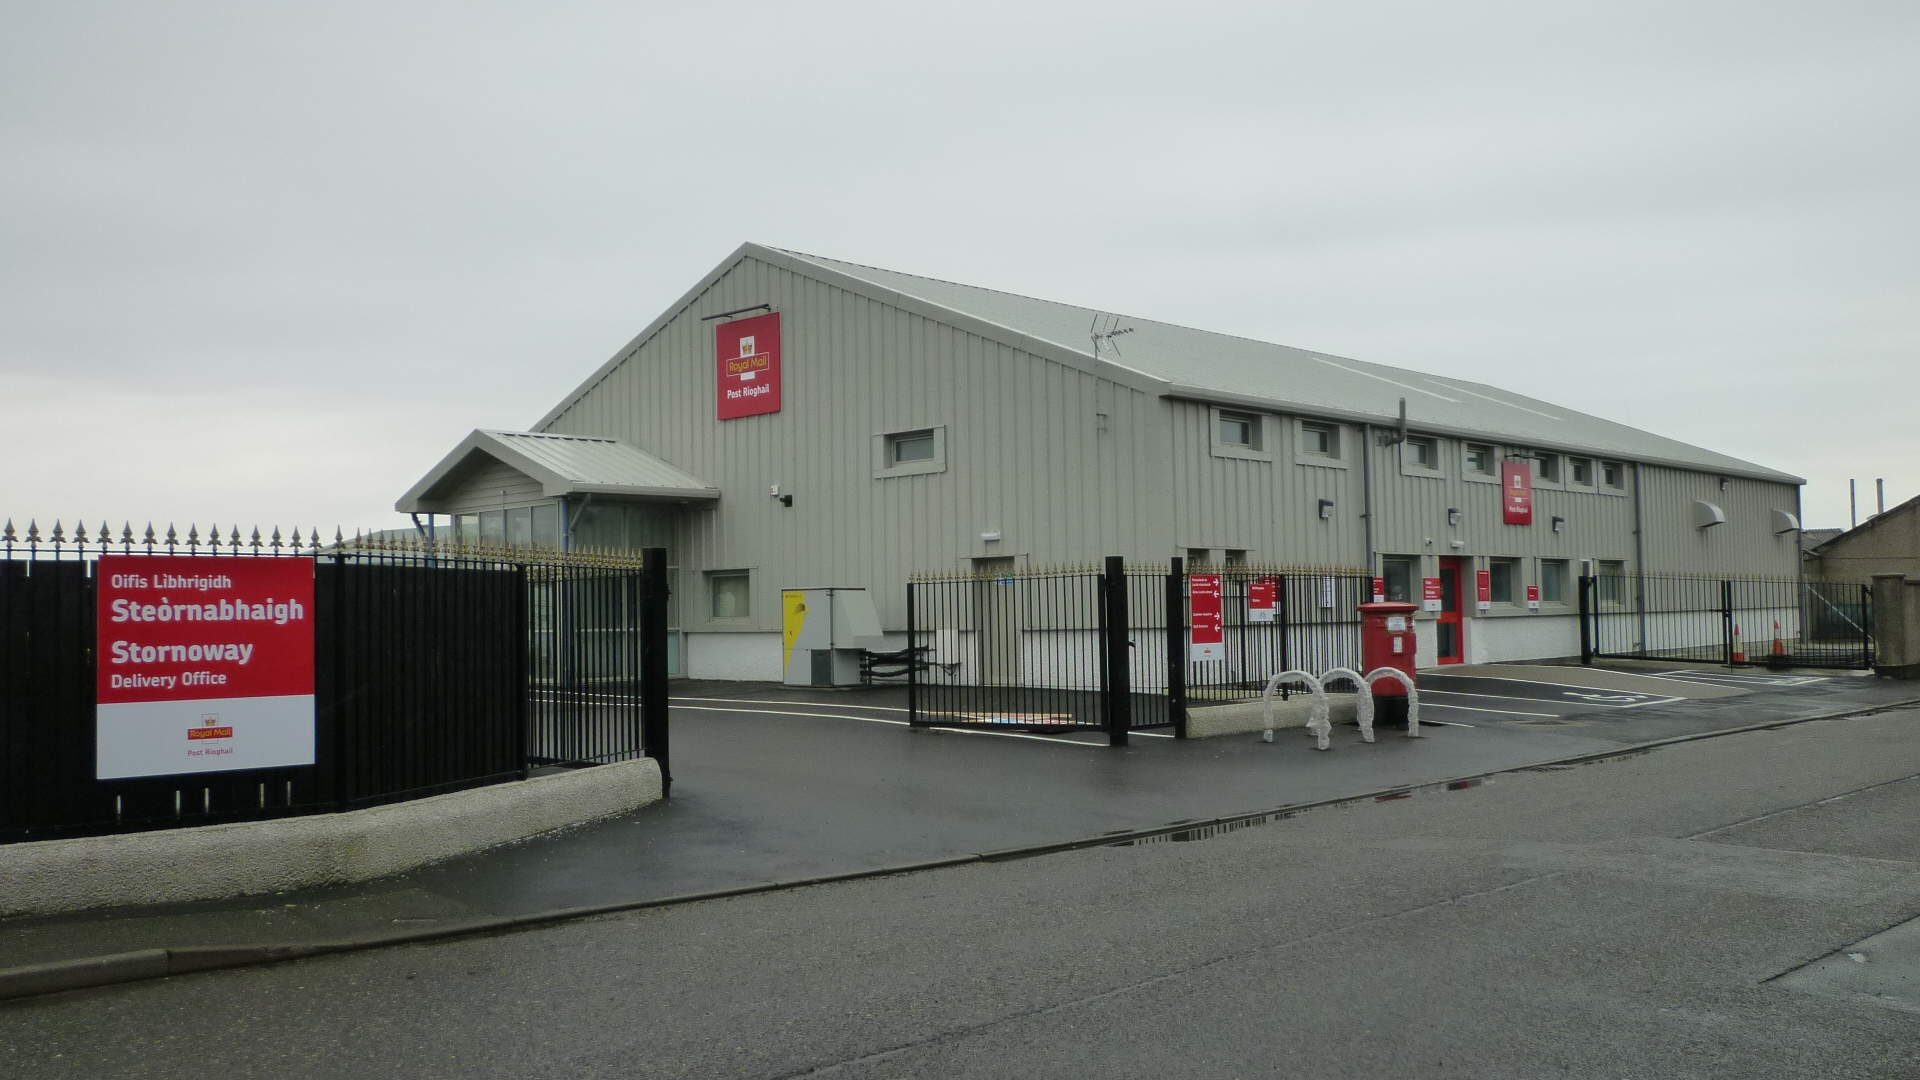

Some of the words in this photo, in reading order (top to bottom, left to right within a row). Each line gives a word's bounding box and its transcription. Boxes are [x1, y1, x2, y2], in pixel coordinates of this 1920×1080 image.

[729, 359, 749, 372] Royal
[750, 356, 767, 368] Mail
[727, 389, 741, 399] Post
[111, 574, 148, 589] Oifis
[153, 573, 232, 591] Lìbhrigidh
[111, 597, 304, 625] Steòrnabhaigh
[111, 640, 254, 665] Stornoway
[111, 673, 177, 690] Delivery
[182, 671, 227, 686] Office
[190, 729, 213, 739] Royal
[213, 728, 231, 736] Mail
[187, 749, 203, 757] Post
